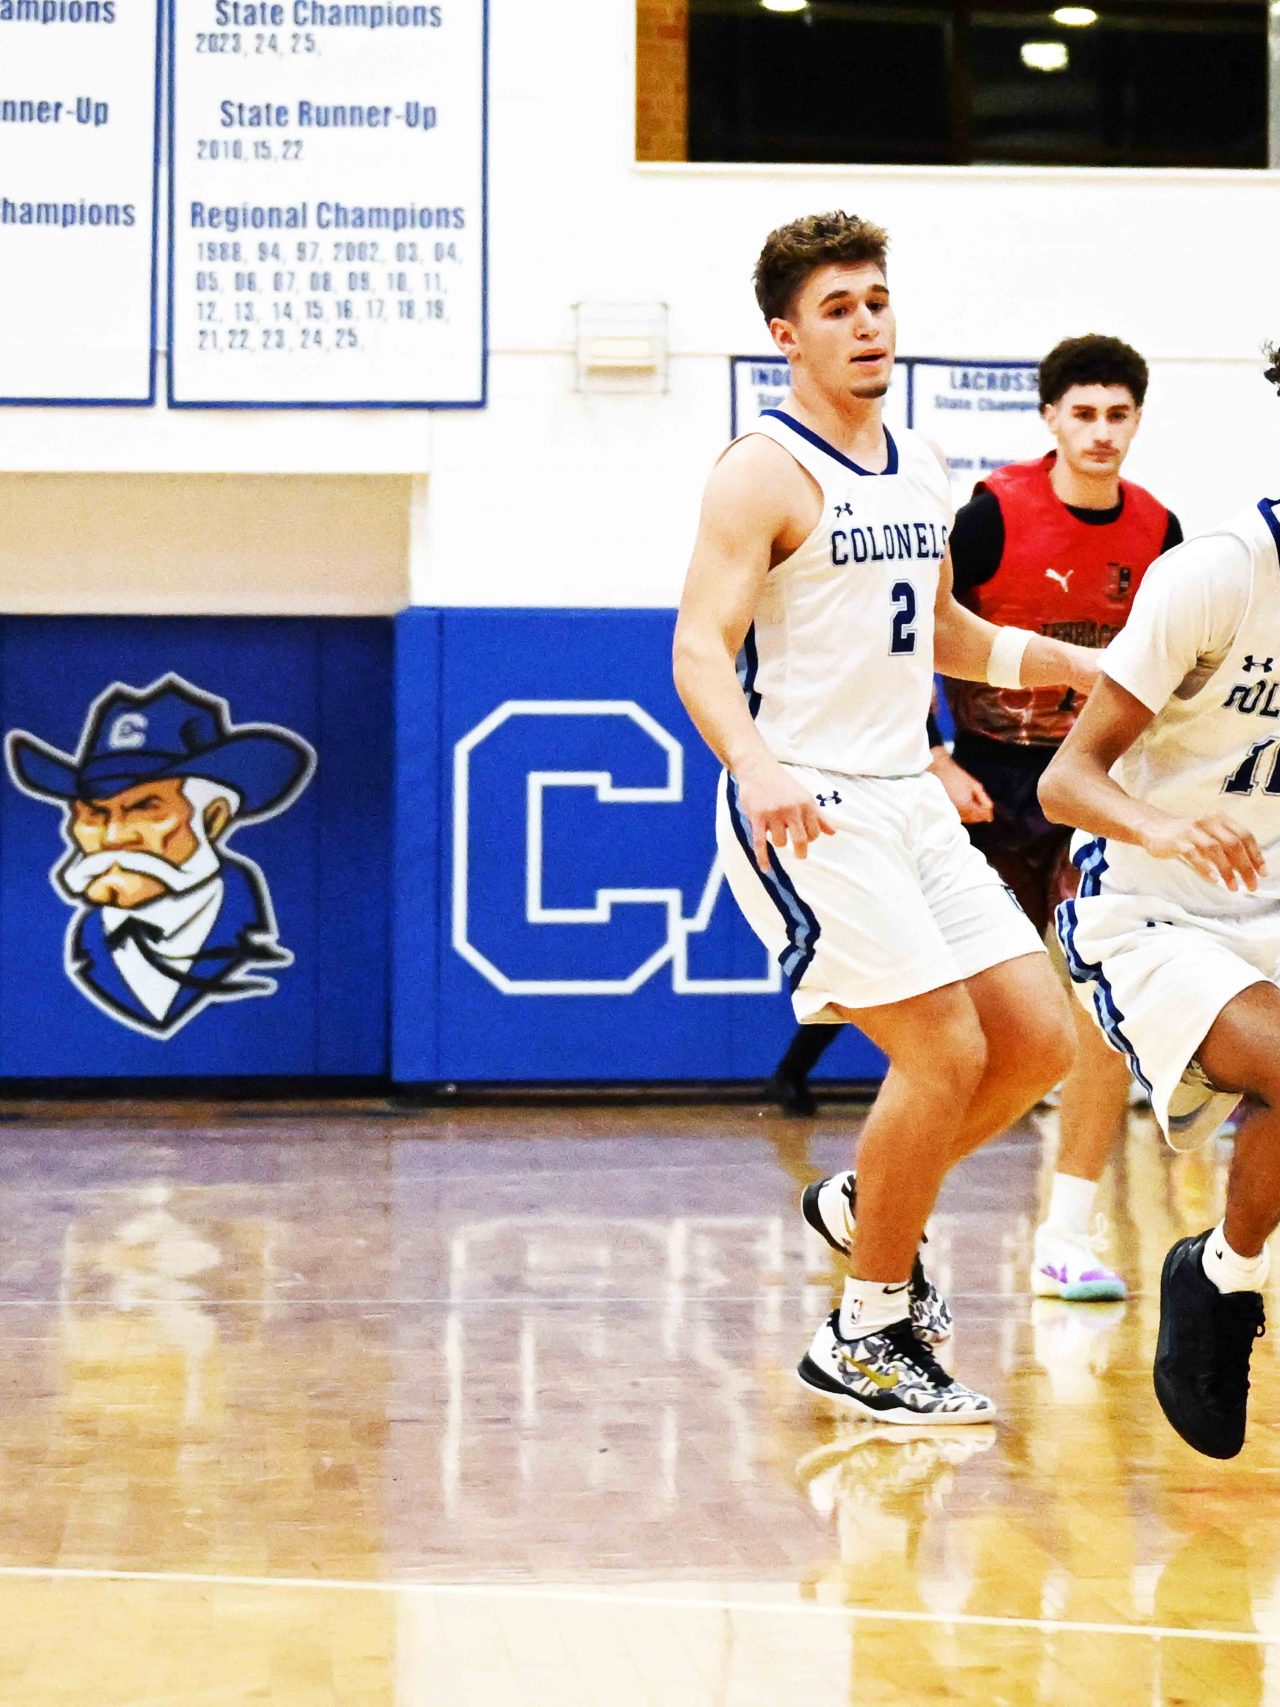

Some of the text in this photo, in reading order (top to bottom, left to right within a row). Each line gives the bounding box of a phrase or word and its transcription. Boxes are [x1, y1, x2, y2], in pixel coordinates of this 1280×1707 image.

[0, 0, 116, 24] ampions
[215, 0, 442, 29] State Champions
[0, 97, 109, 127] nner-Up
[219, 100, 437, 131] State Runner-Up
[0, 196, 136, 229] hampions
[190, 202, 465, 233] Regional Champions
[950, 369, 1040, 391] LACROSS
[889, 579, 917, 656] 2
[109, 712, 149, 750] C
